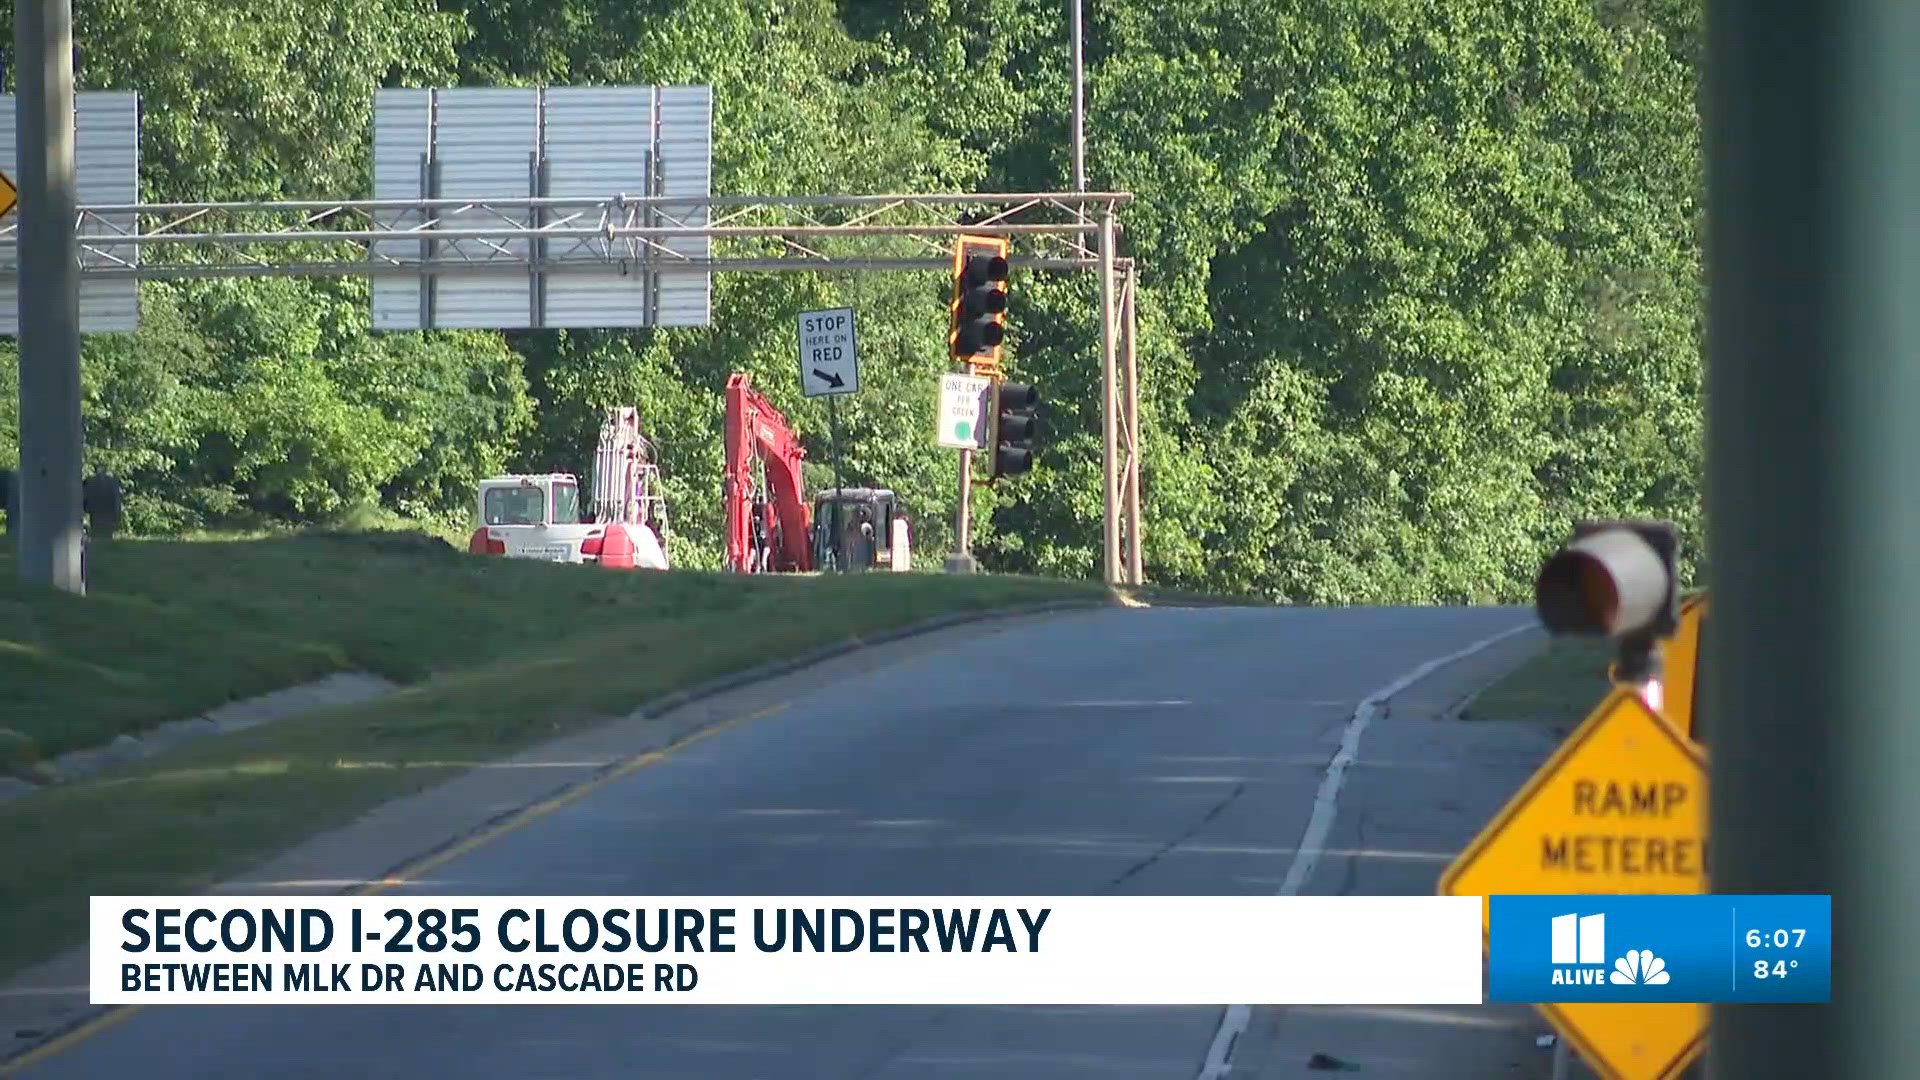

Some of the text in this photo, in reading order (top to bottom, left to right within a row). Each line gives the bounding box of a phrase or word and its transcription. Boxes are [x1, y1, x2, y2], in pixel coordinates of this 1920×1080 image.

[805, 316, 846, 332] STOP
[806, 334, 847, 346] HERE ON
[812, 347, 842, 362] RED
[945, 380, 962, 393] ONE
[1573, 779, 1688, 816] RAMP
[1541, 835, 1708, 875] METERE
